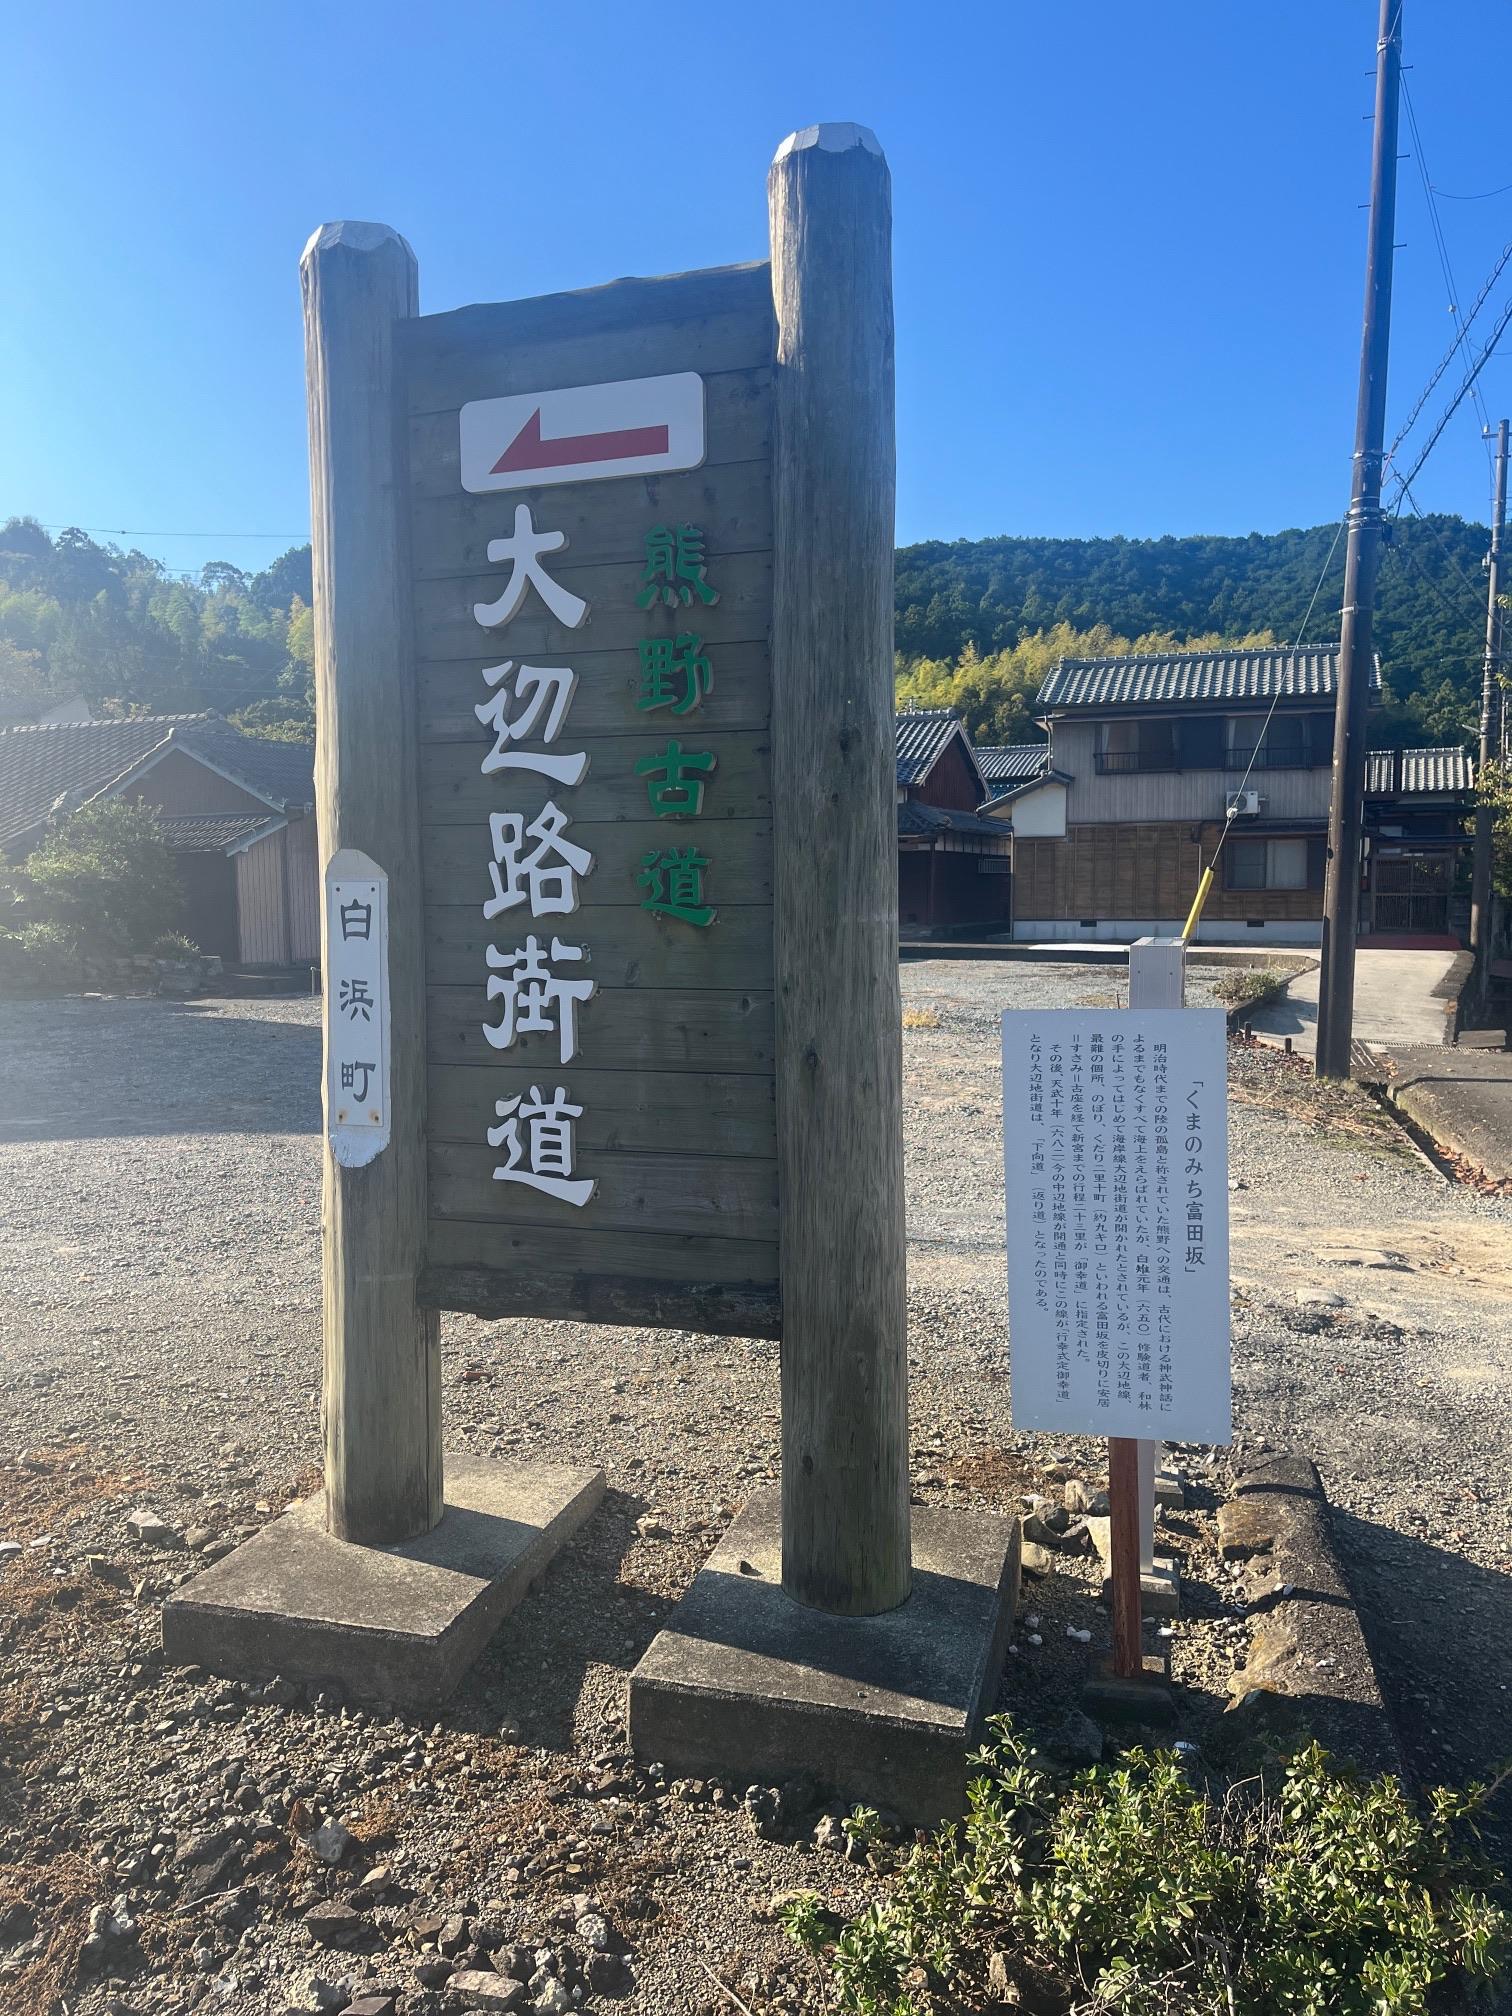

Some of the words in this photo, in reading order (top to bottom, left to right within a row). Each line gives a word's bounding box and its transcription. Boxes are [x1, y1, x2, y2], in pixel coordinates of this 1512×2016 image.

[473, 503, 597, 1207] 大辺路街道
[635, 523, 720, 928] 熊野古道
[340, 898, 376, 1104] 白浜町
[1184, 1080, 1207, 1273] 「くまのみち富田坂」
